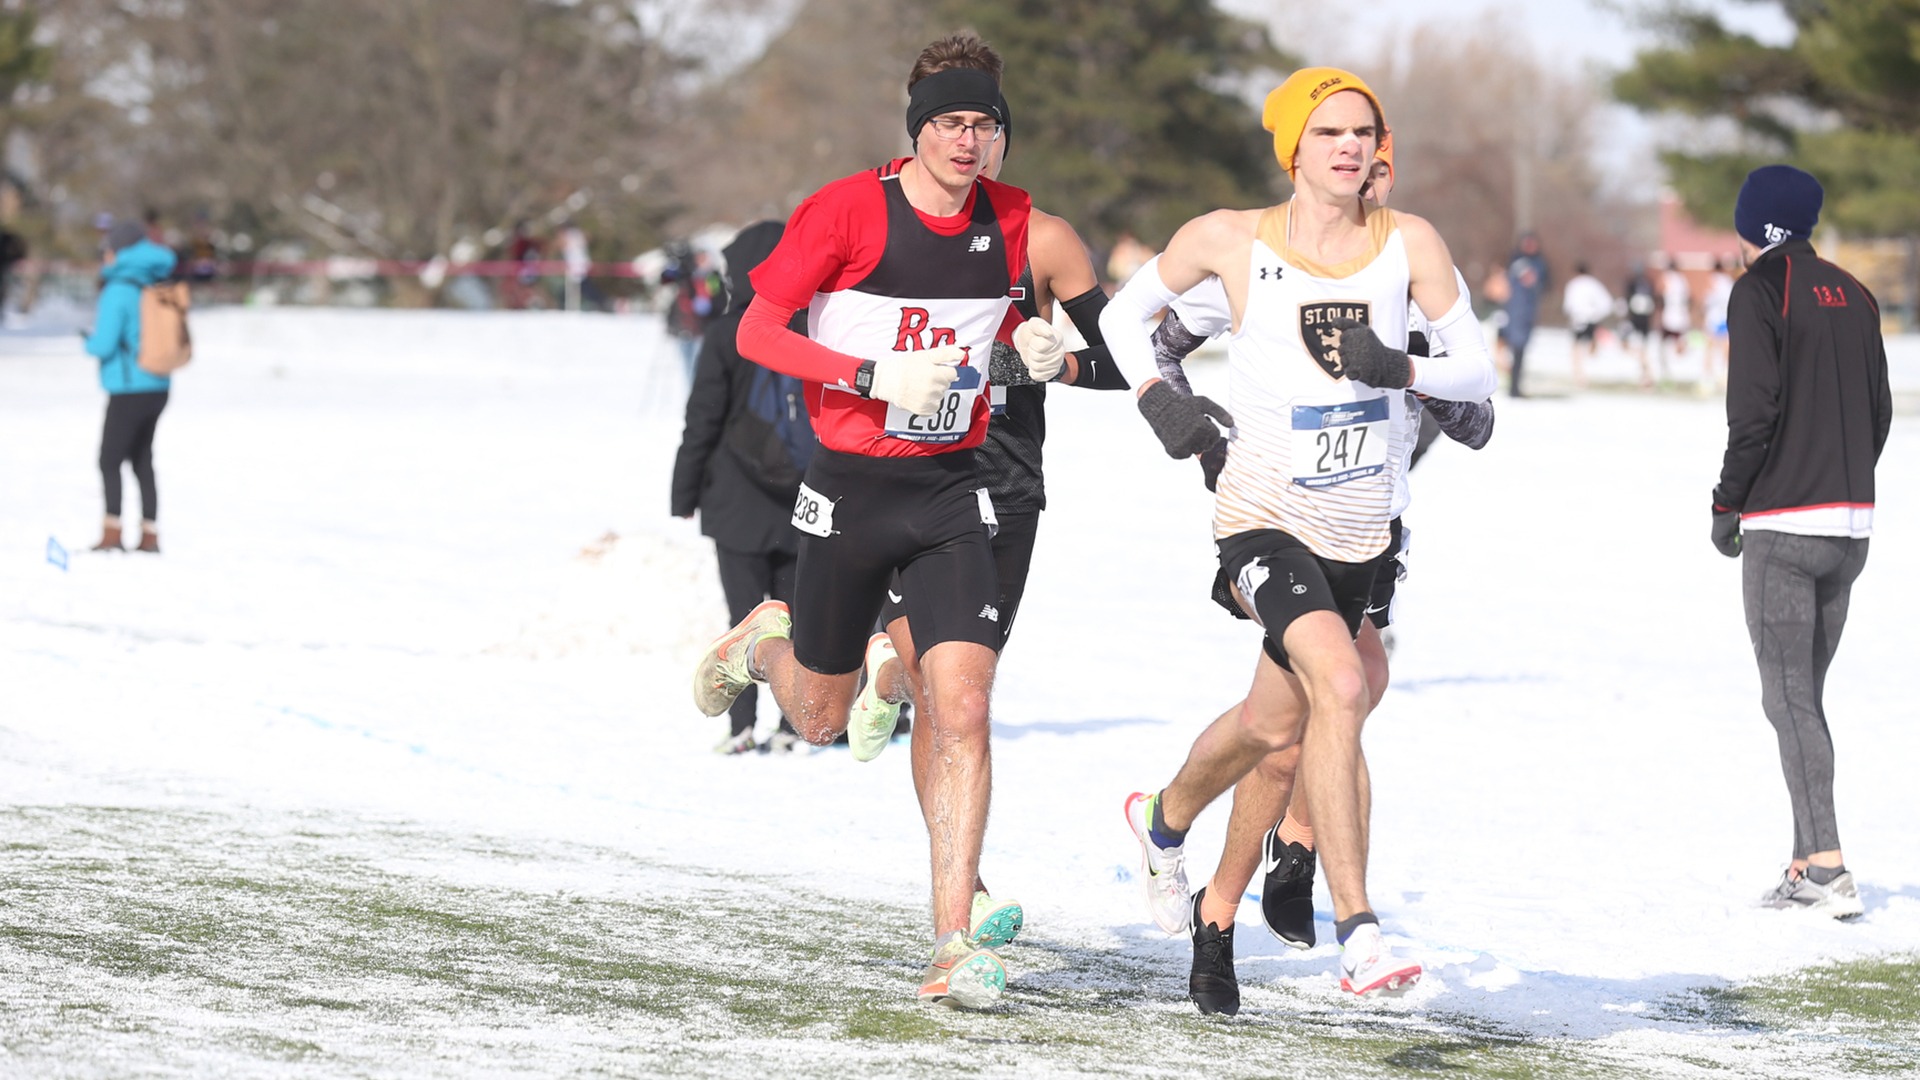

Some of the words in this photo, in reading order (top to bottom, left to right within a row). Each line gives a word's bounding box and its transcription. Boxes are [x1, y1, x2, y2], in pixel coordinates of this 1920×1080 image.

[1813, 286, 1848, 302] 13.1
[1305, 308, 1325, 325] ST.
[1327, 307, 1364, 323] OLAF
[1316, 425, 1368, 474] 247
